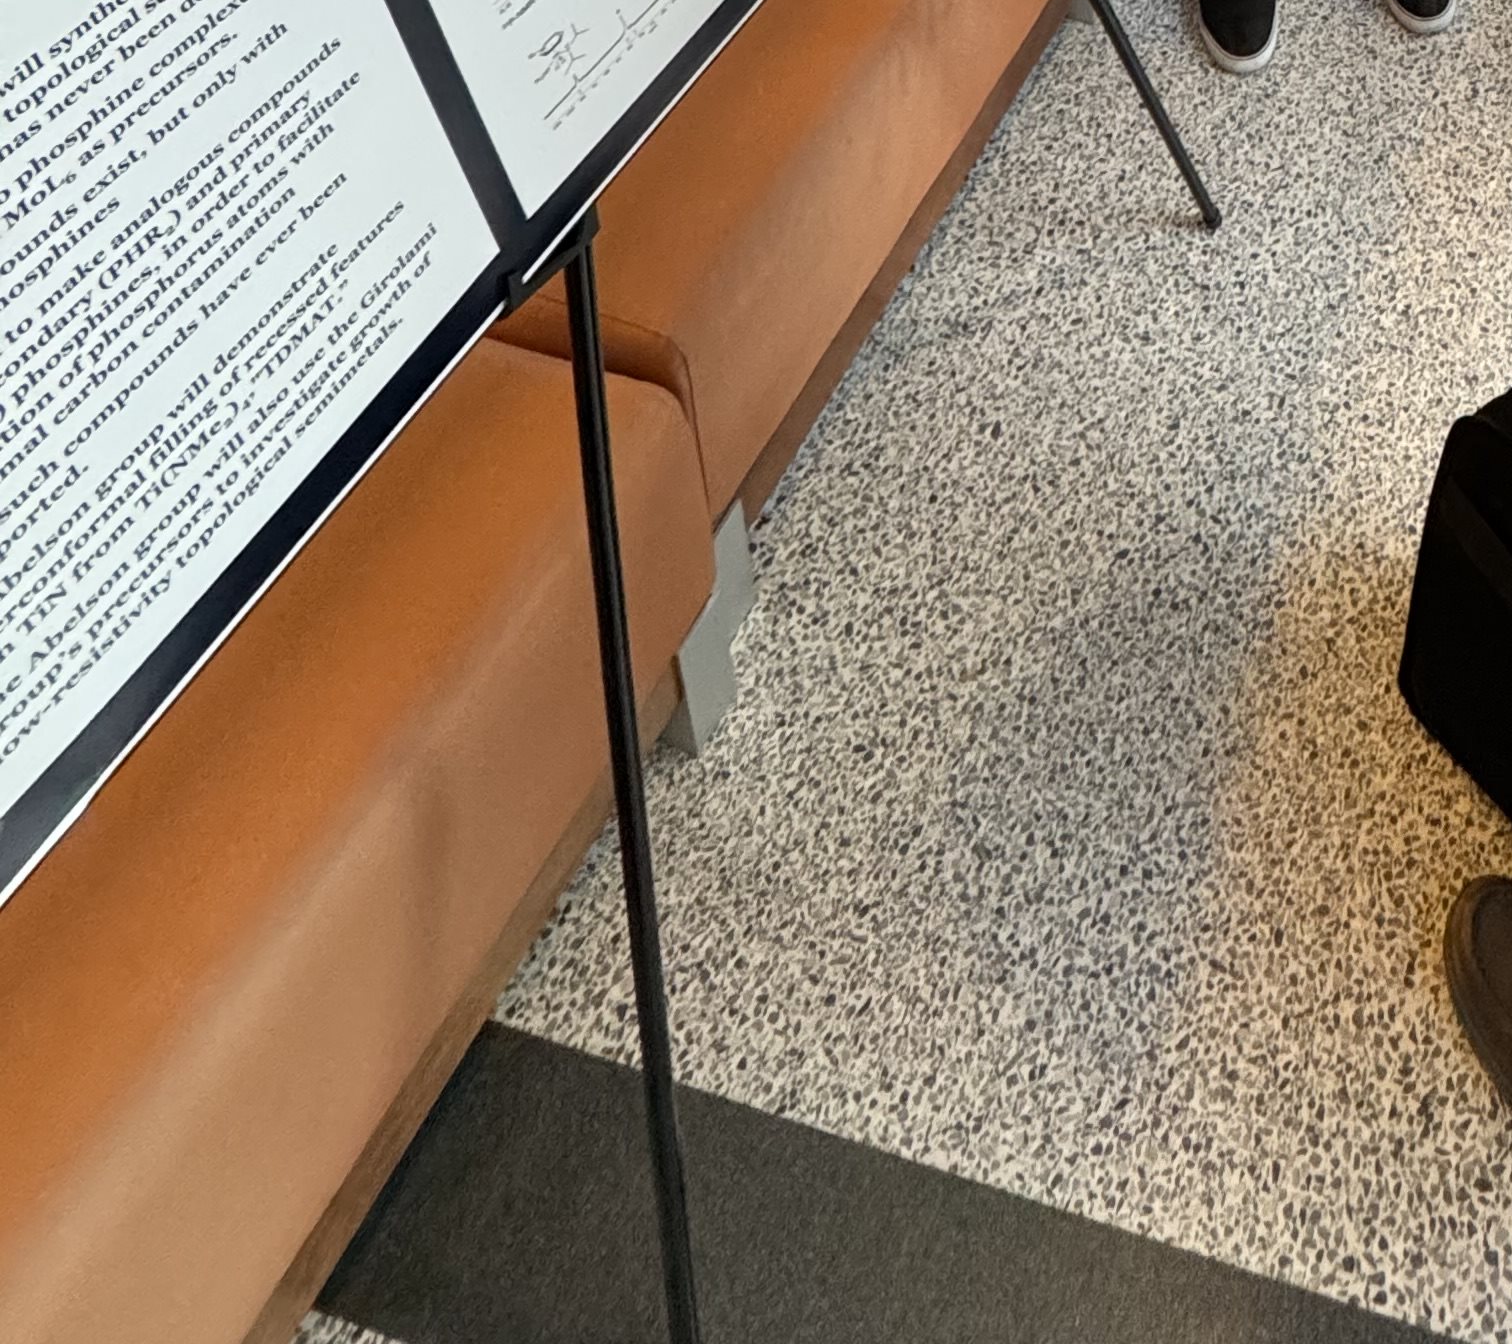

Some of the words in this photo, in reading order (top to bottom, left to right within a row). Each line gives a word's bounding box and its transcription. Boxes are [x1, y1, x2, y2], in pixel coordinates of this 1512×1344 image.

[3, 6, 143, 123] topological
[12, 76, 146, 194] phosphine
[44, 58, 116, 123] never
[114, 12, 178, 63] been
[77, 138, 107, 168] as
[107, 32, 239, 146] precursors.
[82, 149, 148, 205] exist,
[145, 106, 191, 147] but
[191, 63, 238, 109] only
[239, 23, 289, 65] with
[4, 316, 34, 345] to
[35, 249, 107, 318] make
[109, 142, 225, 251] analogous
[227, 37, 342, 144] compounds
[63, 319, 200, 458] compounds
[198, 266, 253, 321] have
[254, 218, 298, 267] ever
[297, 172, 348, 222] been
[94, 423, 165, 503] group
[165, 372, 211, 420] will
[212, 243, 339, 376] demonstrate
[28, 561, 131, 675] Abelson
[132, 482, 202, 563] group
[202, 431, 246, 479] will
[246, 386, 290, 435] also
[290, 346, 326, 386] use
[326, 310, 359, 347] the
[359, 221, 438, 310] Girolami
[175, 434, 294, 569] topological
[294, 317, 404, 439] semimetals.
